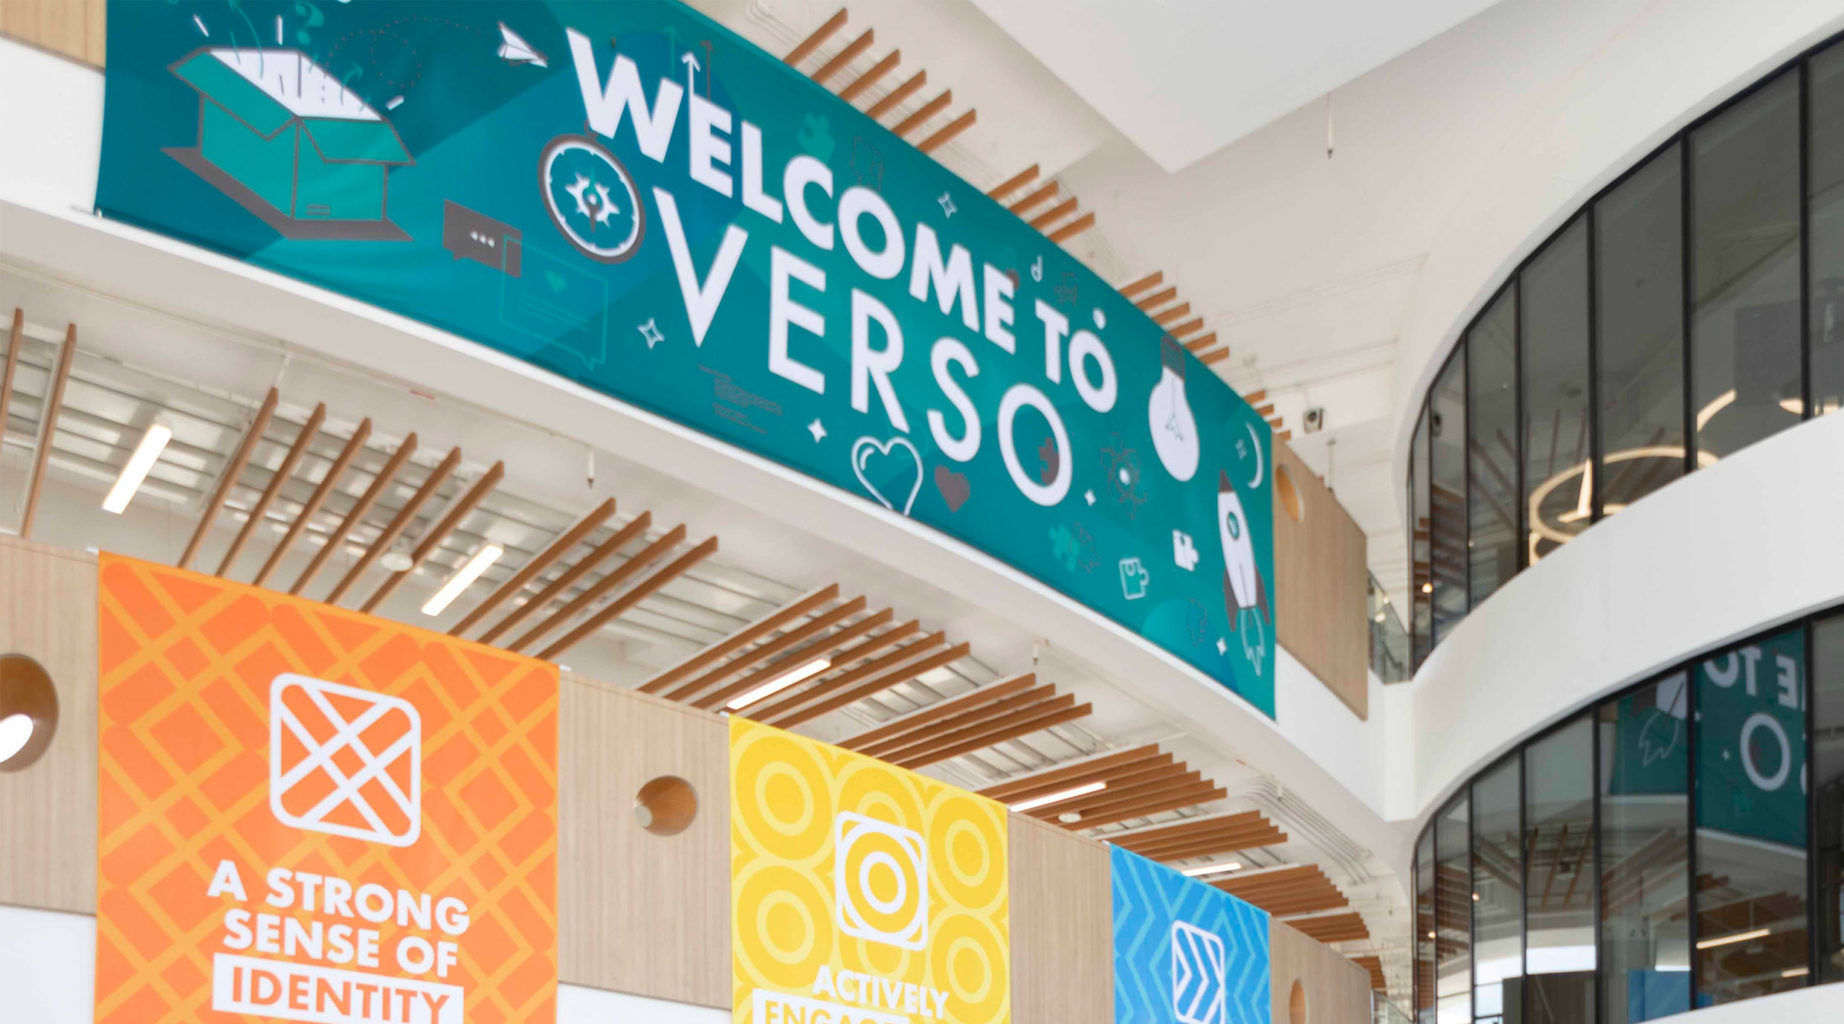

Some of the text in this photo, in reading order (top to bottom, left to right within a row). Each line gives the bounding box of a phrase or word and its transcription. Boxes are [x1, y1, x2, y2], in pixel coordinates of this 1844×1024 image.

[565, 28, 1118, 413] WELCOME TO
[652, 187, 1073, 506] VERSO
[206, 859, 471, 937] A STRONG
[222, 908, 459, 978] SENSE OF
[811, 964, 949, 1020] ACTIVELY
